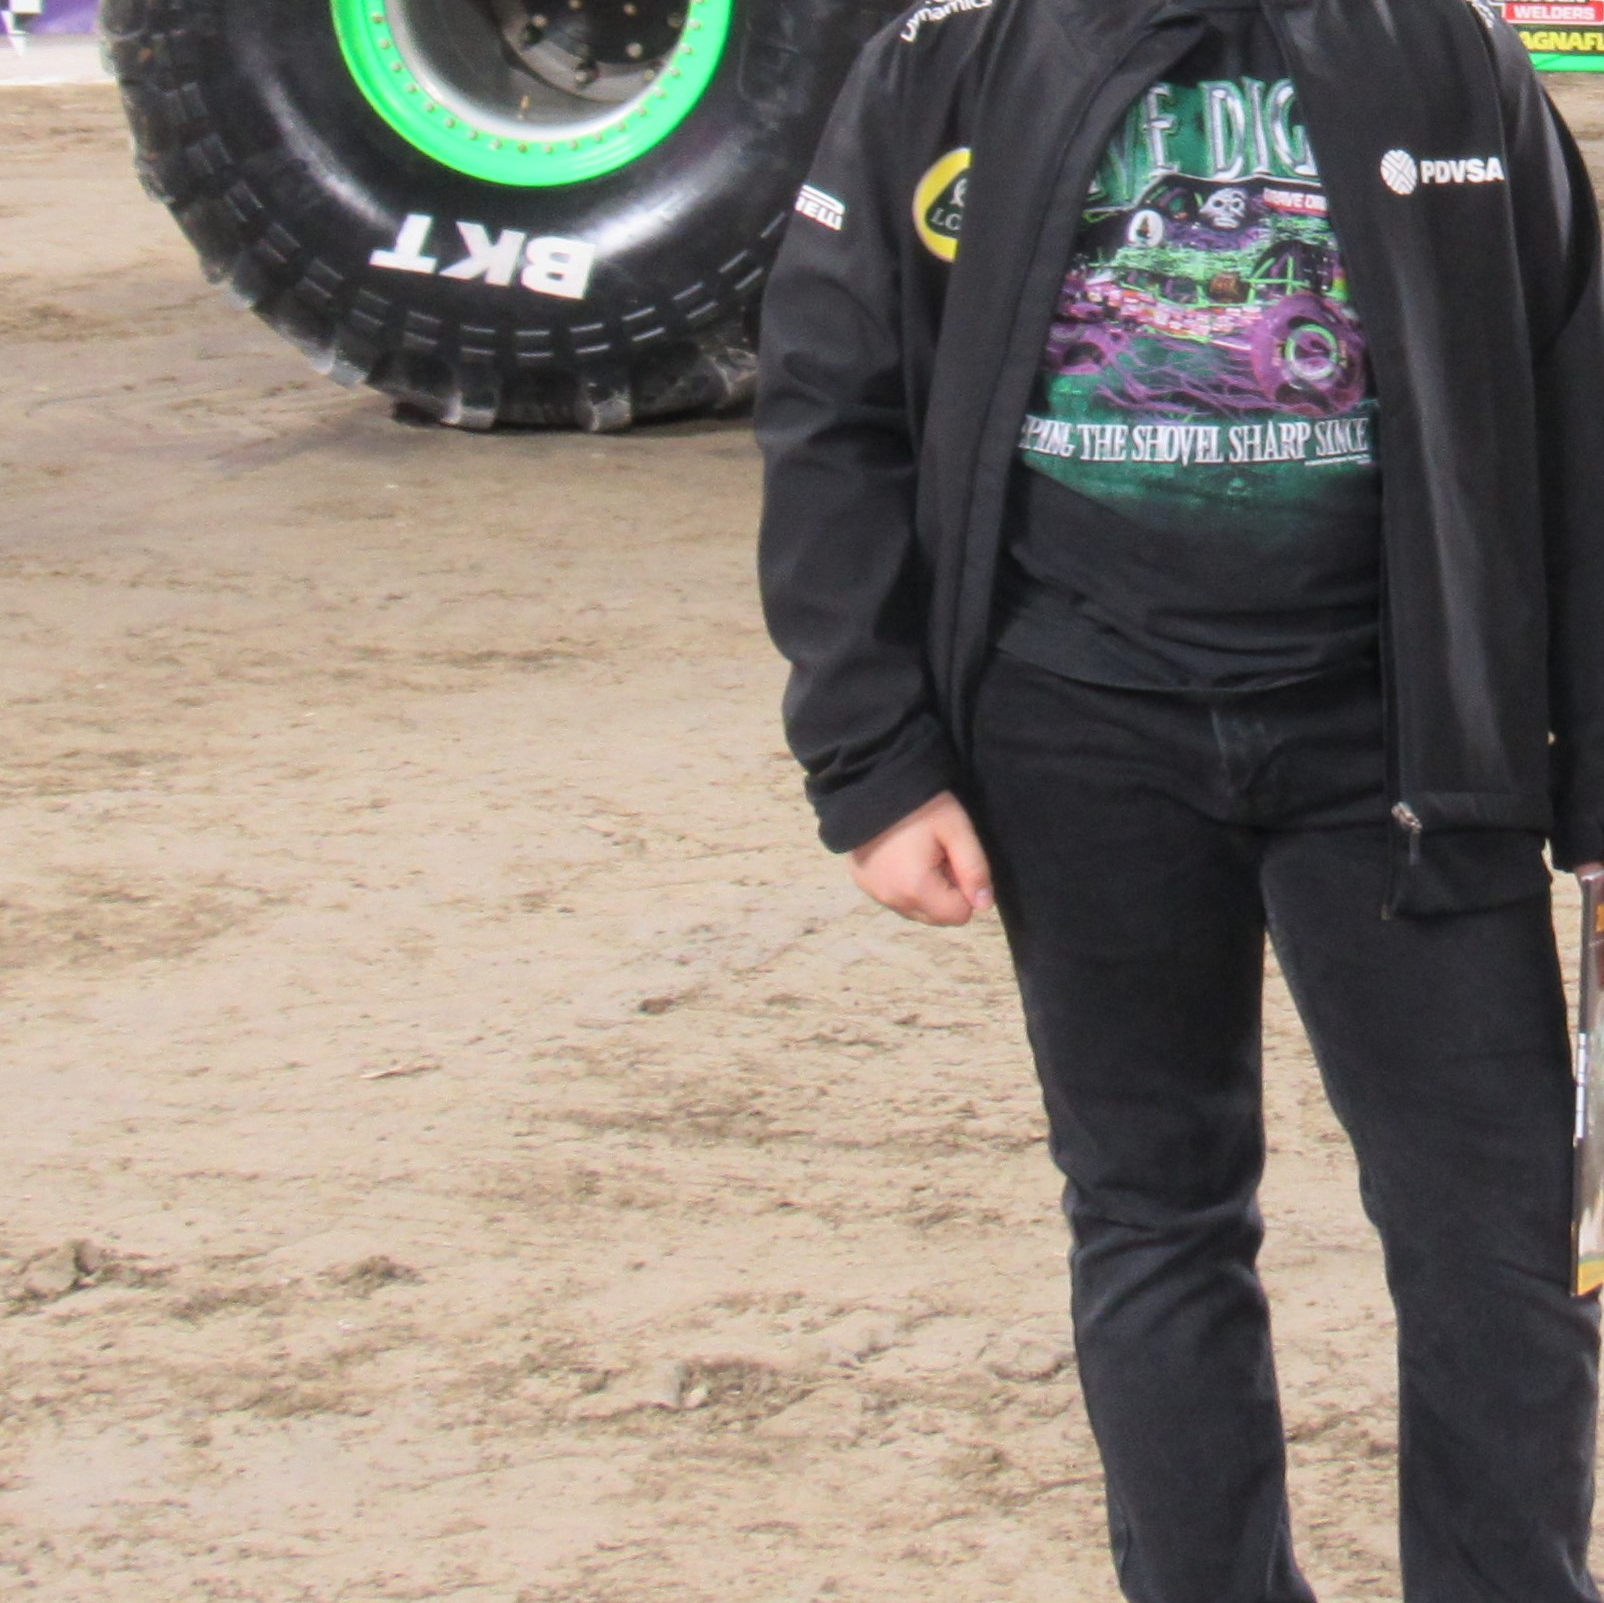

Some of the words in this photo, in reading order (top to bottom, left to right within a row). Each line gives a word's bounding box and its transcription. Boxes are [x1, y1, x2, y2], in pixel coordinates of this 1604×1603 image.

[1513, 4, 1596, 21] WELDERS
[1420, 157, 1505, 184] PDVSA
[368, 212, 597, 301] BKT
[1077, 423, 1129, 461] THE
[1132, 424, 1224, 466] SHOVEL
[1228, 420, 1311, 464] SHARP
[1314, 417, 1369, 456] SINCE
